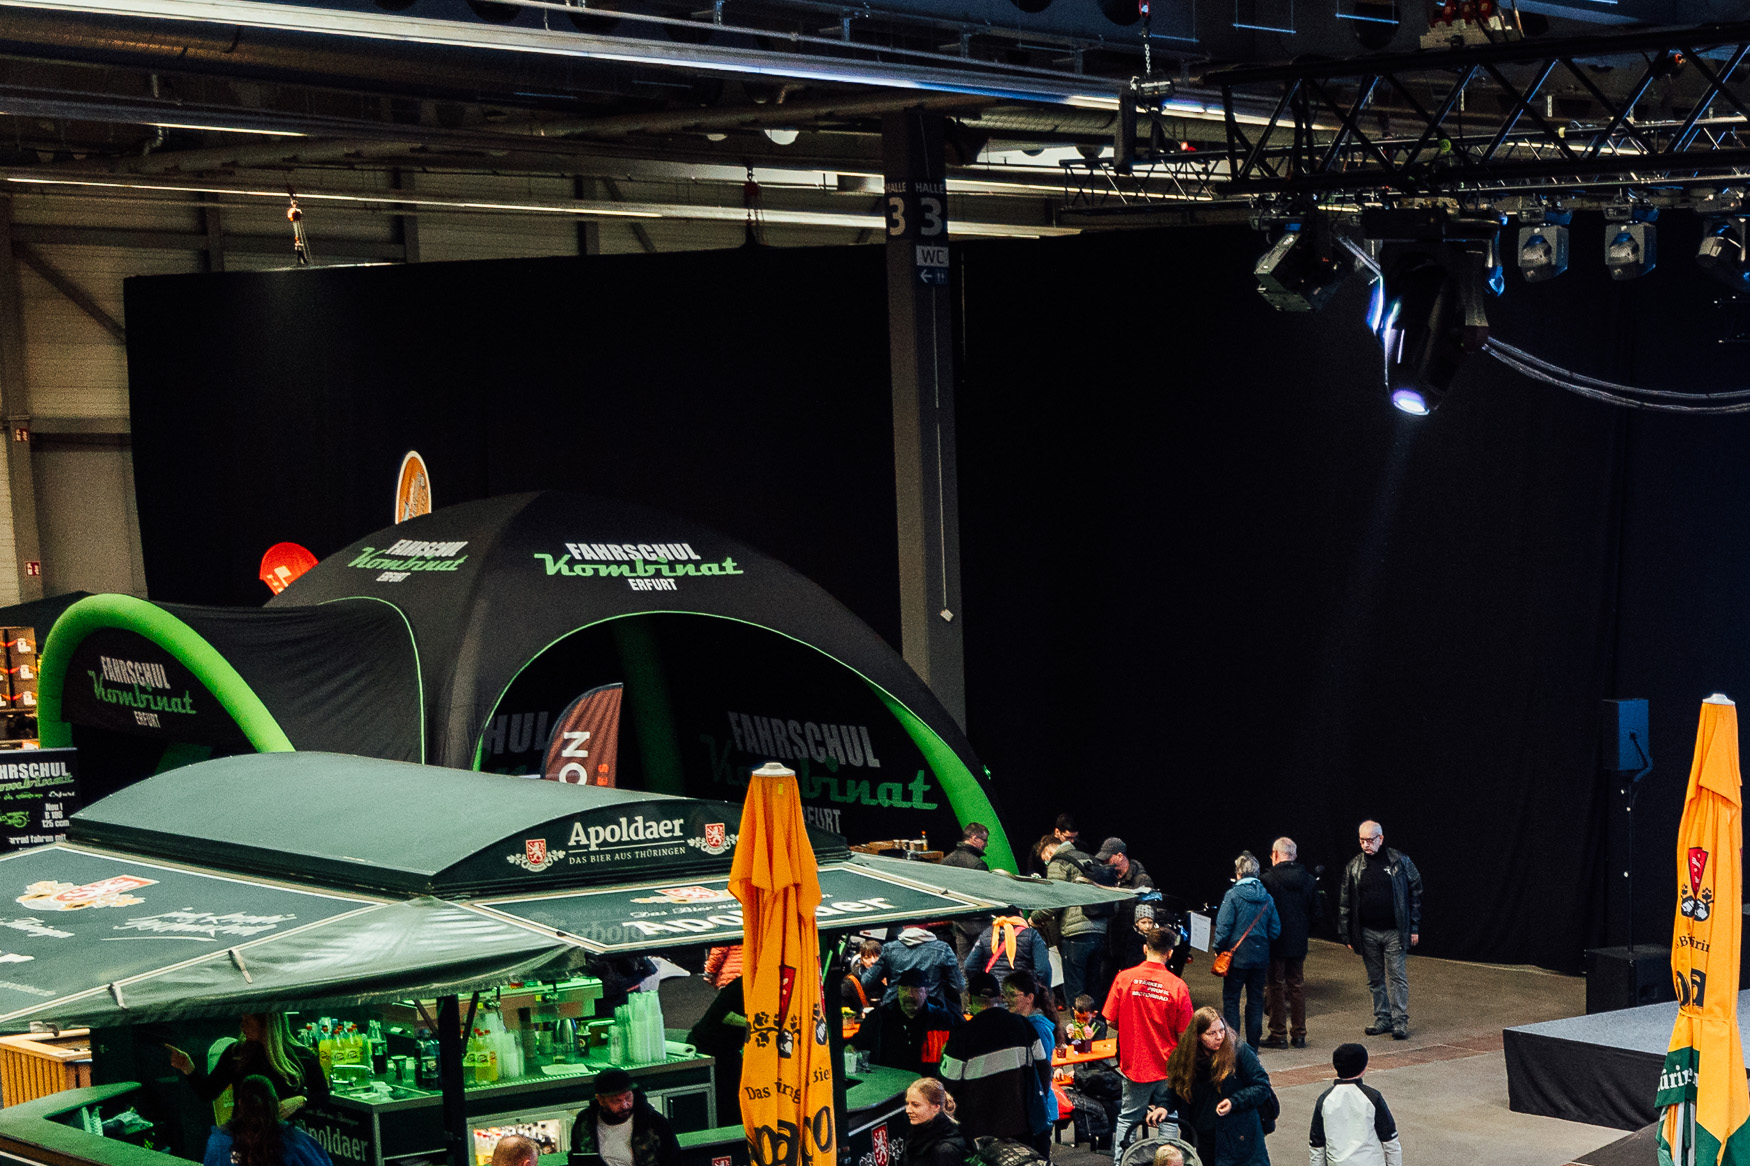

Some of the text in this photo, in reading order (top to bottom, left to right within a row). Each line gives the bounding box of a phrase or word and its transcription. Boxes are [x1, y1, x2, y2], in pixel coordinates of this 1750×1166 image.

[886, 182, 907, 193] HALLE
[915, 182, 945, 194] HALLE
[888, 196, 906, 236] 3
[920, 196, 943, 236] 3
[921, 250, 945, 265] WC
[565, 542, 702, 561] FAHRSCHUL
[534, 552, 744, 577] Kombinat
[627, 578, 678, 591] ERFURT
[100, 655, 172, 690] FAHRSCHUL
[87, 669, 197, 714] Kombinat
[727, 710, 881, 769] FAHRSCHUL
[567, 815, 685, 852] Apoldaer
[569, 845, 687, 866] DAS BIER AUS THÜRINGEN
[744, 1086, 772, 1101] Das
[303, 1121, 369, 1162] poldaer
